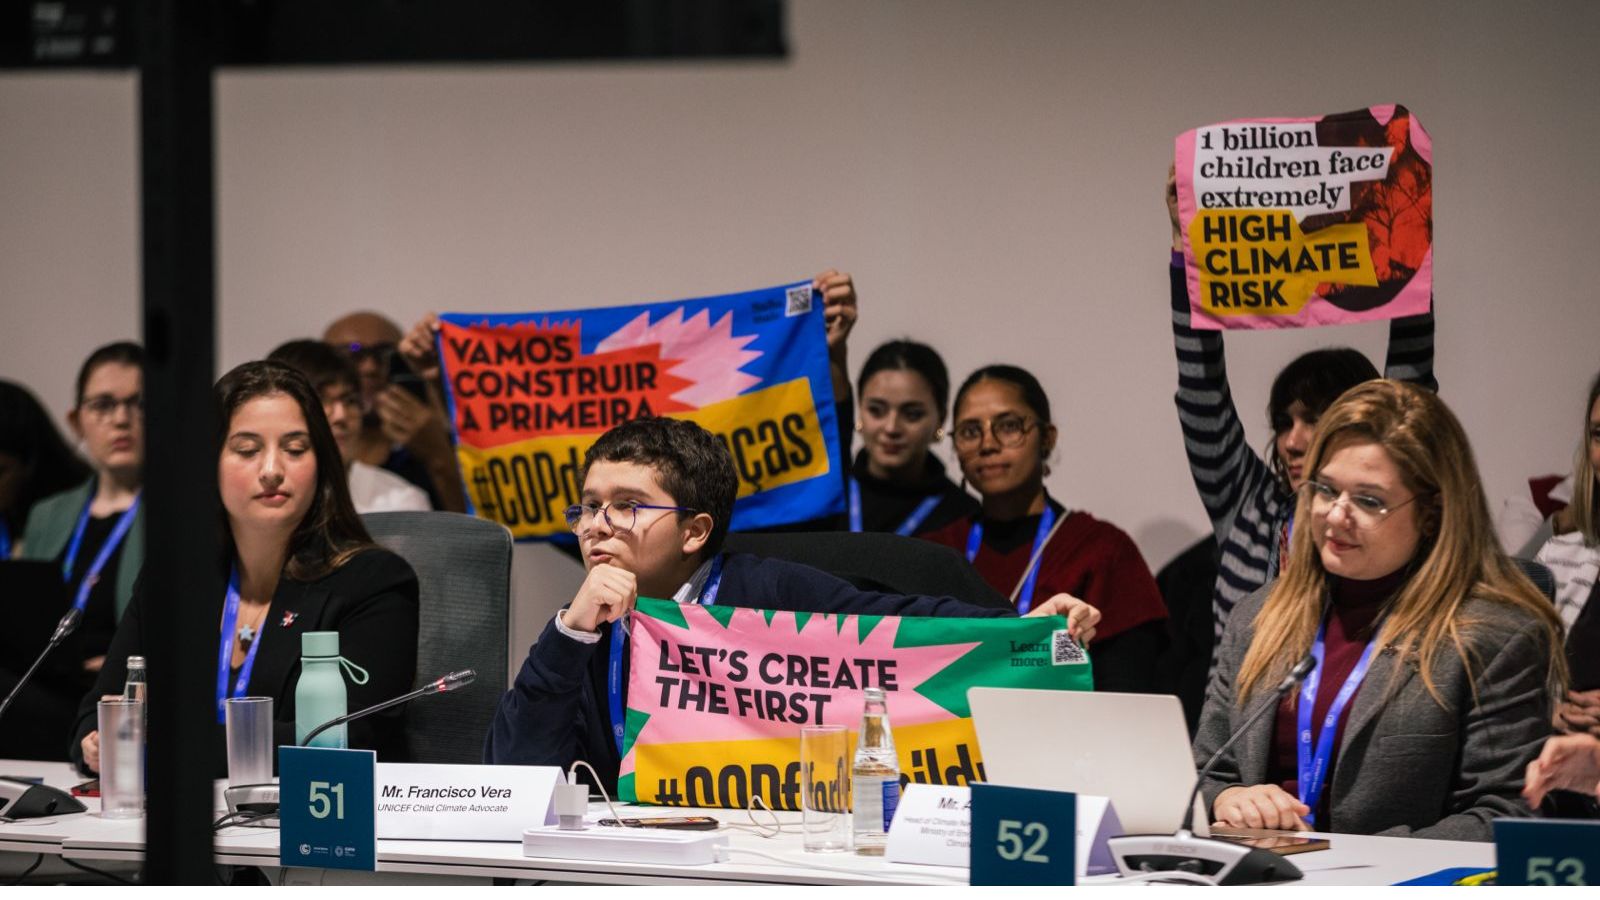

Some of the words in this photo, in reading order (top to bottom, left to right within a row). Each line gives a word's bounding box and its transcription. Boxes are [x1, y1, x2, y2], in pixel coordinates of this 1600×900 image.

[1201, 131, 1213, 149] 1
[1222, 126, 1313, 151] billion
[1200, 155, 1322, 179] children
[1328, 151, 1385, 175] face
[1201, 181, 1344, 209] extremely
[1203, 214, 1291, 243] HIGH
[1205, 241, 1360, 276] CLIMATE
[1210, 279, 1288, 307] RISK
[450, 335, 573, 365] VAMOS
[455, 362, 657, 398] CONSTRUIR
[462, 404, 480, 431] A
[489, 396, 655, 432] PRIMEIRA
[1009, 640, 1050, 653] Learn
[658, 639, 749, 682] LET'S
[759, 652, 899, 692] CREATE
[656, 676, 729, 715] THE
[734, 687, 832, 726] FIRST
[309, 781, 344, 819] 51
[381, 785, 403, 798] Mr.
[407, 785, 476, 799] Francisco
[481, 785, 512, 798] Vera
[938, 797, 959, 810] Mr.
[377, 804, 411, 813] UNICEF
[412, 803, 434, 813] Child
[435, 803, 467, 813] Climate
[468, 804, 508, 813] Advocate
[996, 819, 1049, 863] 52
[1527, 856, 1586, 886] 53
